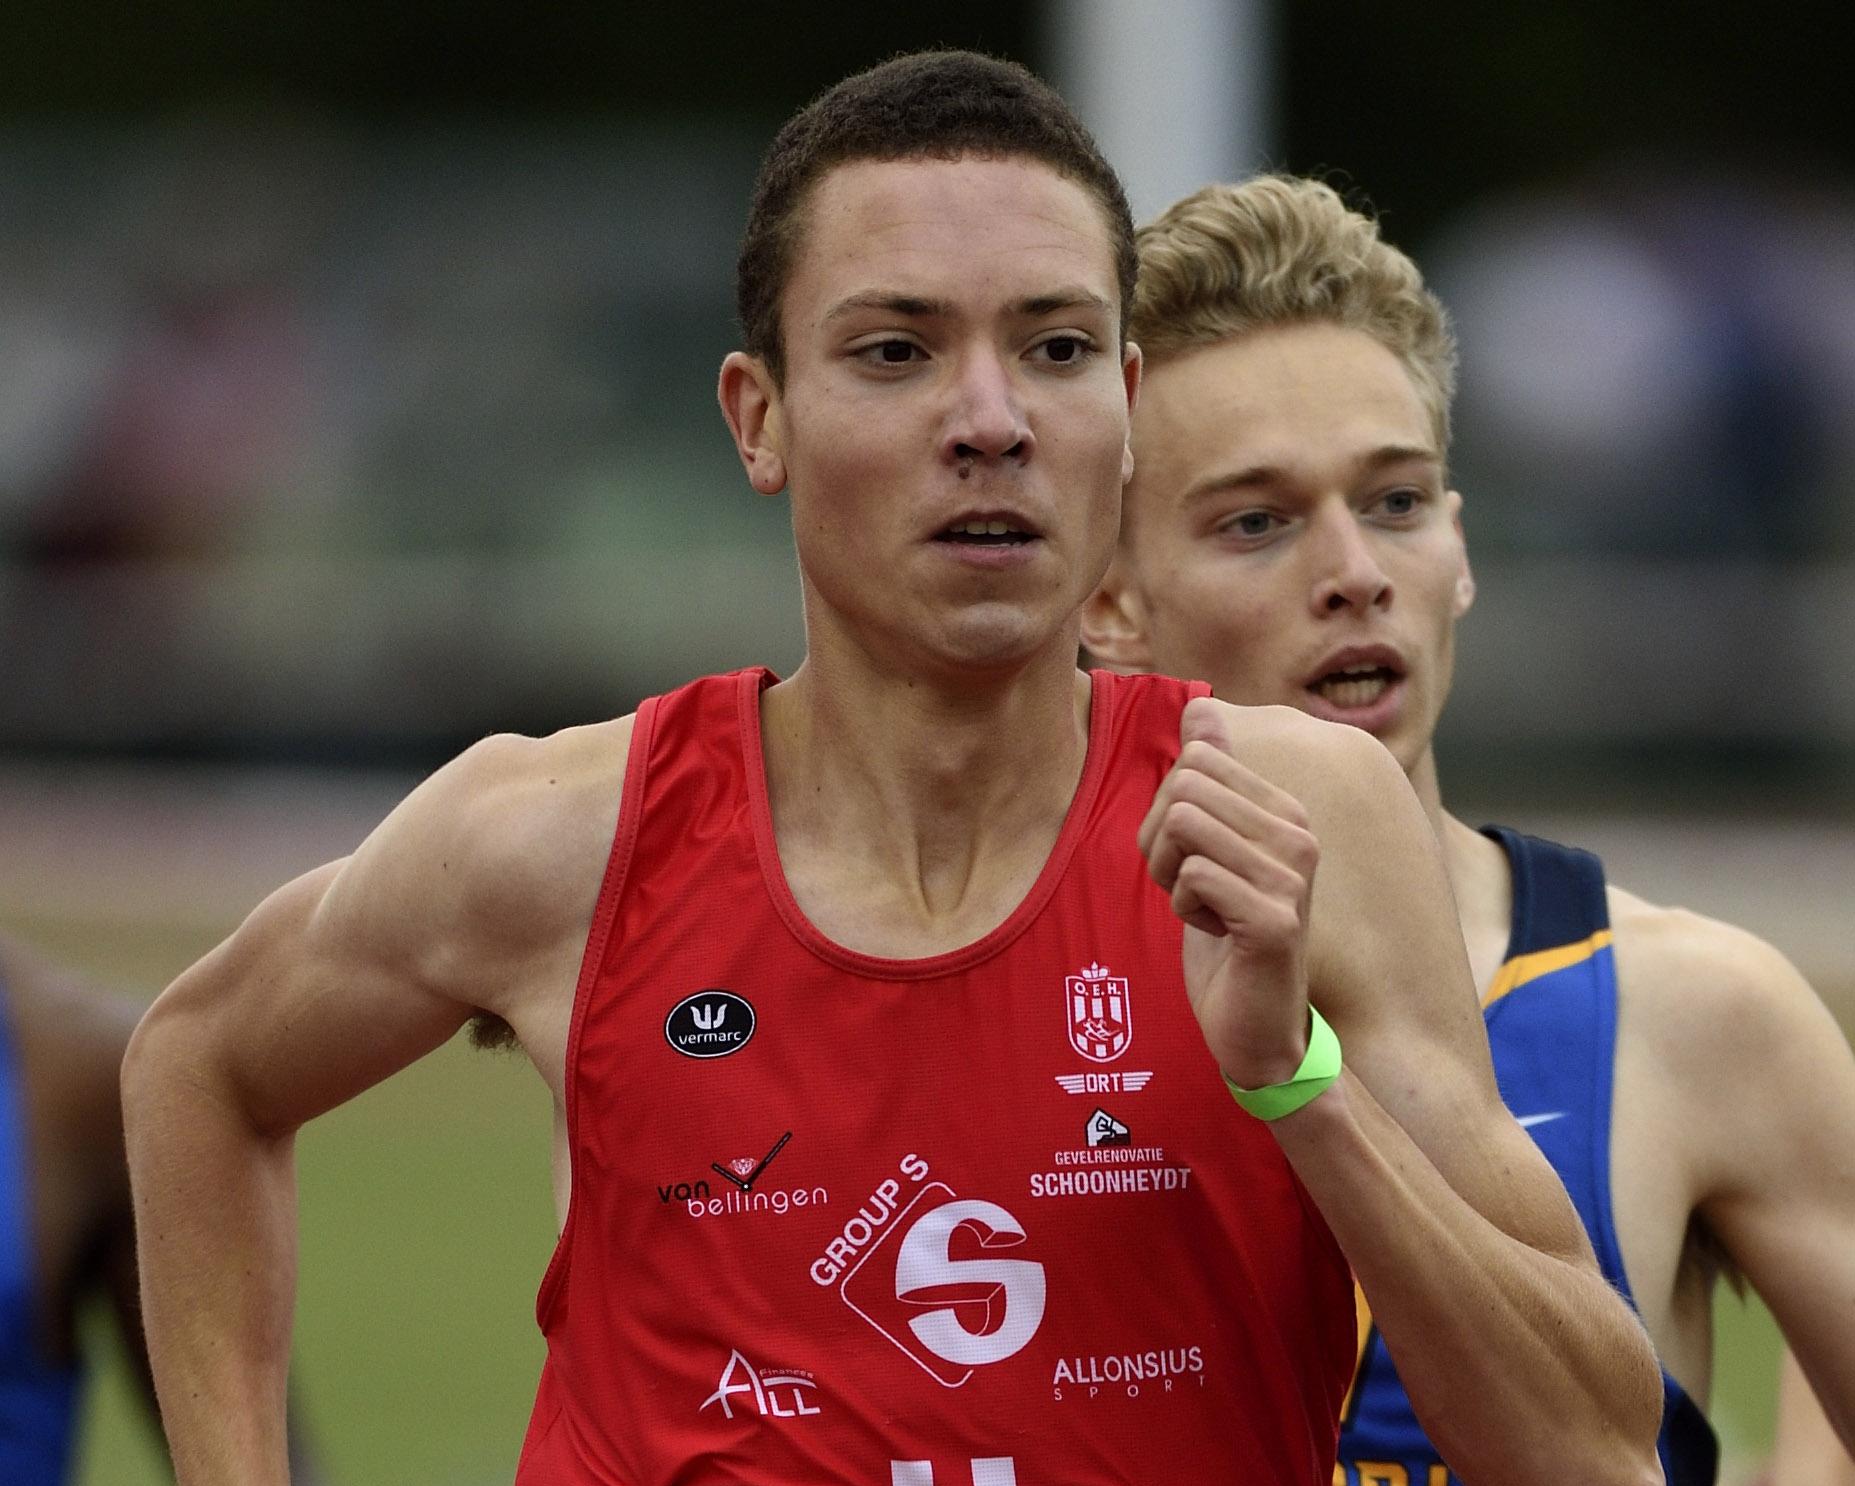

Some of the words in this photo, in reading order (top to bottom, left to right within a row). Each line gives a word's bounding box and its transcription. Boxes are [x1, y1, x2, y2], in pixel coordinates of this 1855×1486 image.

[678, 1030, 742, 1045] vermarc
[1086, 1073, 1121, 1093] ORT
[1054, 1147, 1164, 1165] GEVELRENOVATIE
[657, 1180, 710, 1203] van
[1030, 1168, 1192, 1198] SCHOONHEYDT
[687, 1187, 828, 1218] bellingen
[809, 1178, 901, 1287] GROUP
[900, 1153, 929, 1182] S
[1053, 1346, 1204, 1385] ALLONSIUS
